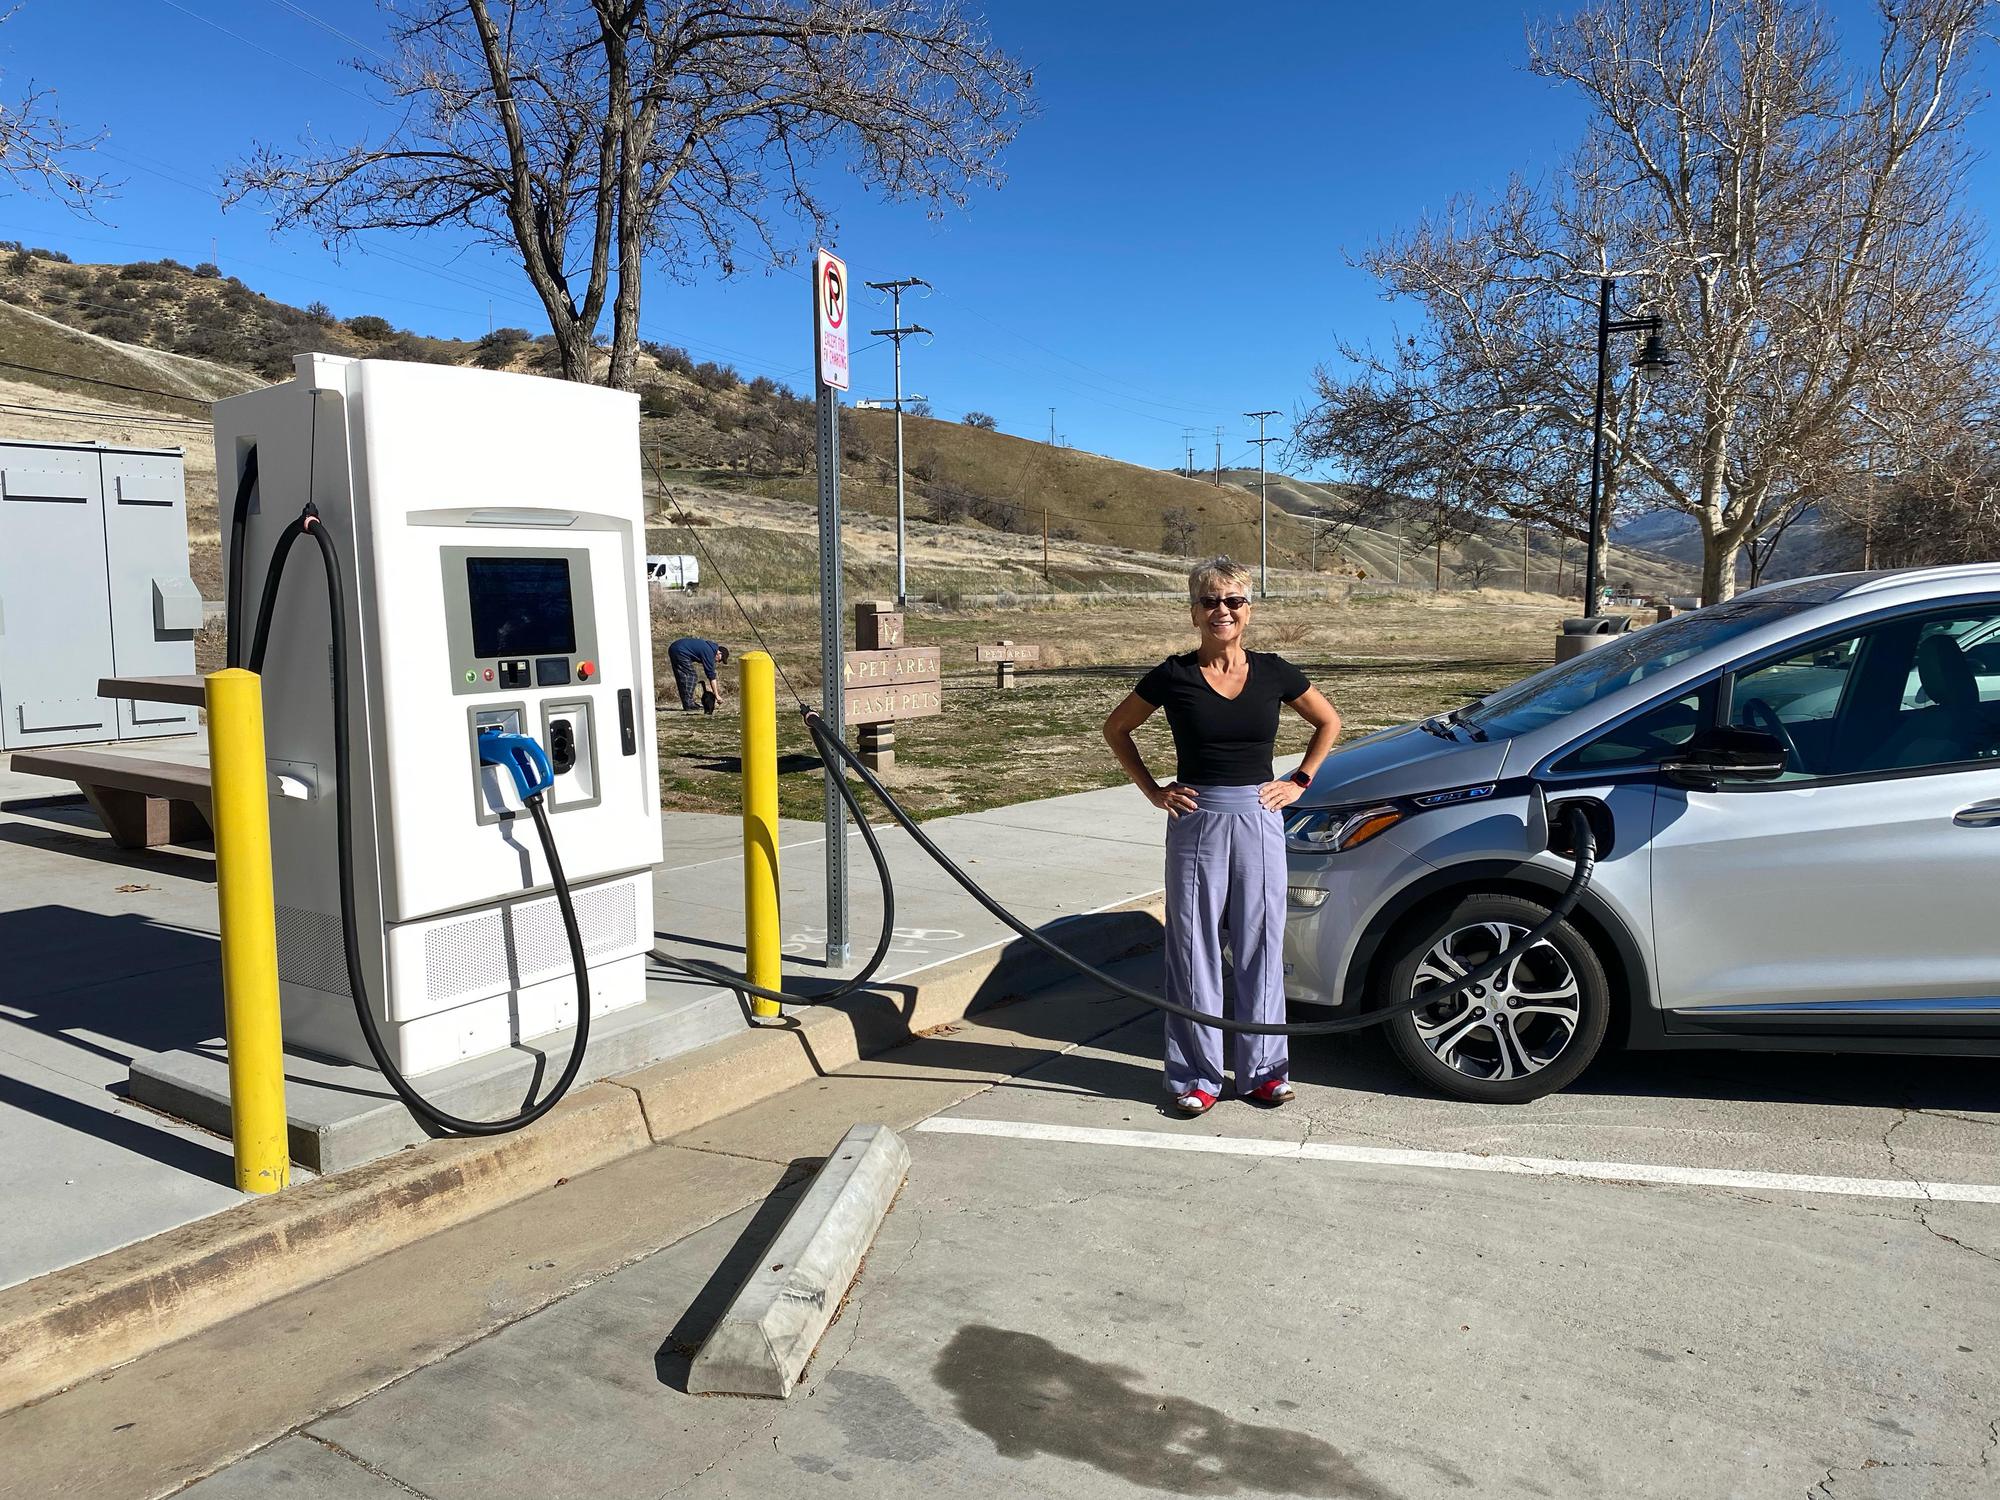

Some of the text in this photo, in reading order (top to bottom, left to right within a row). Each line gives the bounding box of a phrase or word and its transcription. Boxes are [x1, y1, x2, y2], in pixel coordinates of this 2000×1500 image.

[829, 270, 840, 316] P
[824, 331, 838, 350] EXCEPT
[823, 347, 829, 362] EV
[985, 649, 1032, 658] PET AREA
[859, 656, 937, 678] PET AREA
[846, 691, 939, 716] EASH PETS
[1470, 787, 1489, 796] EV
